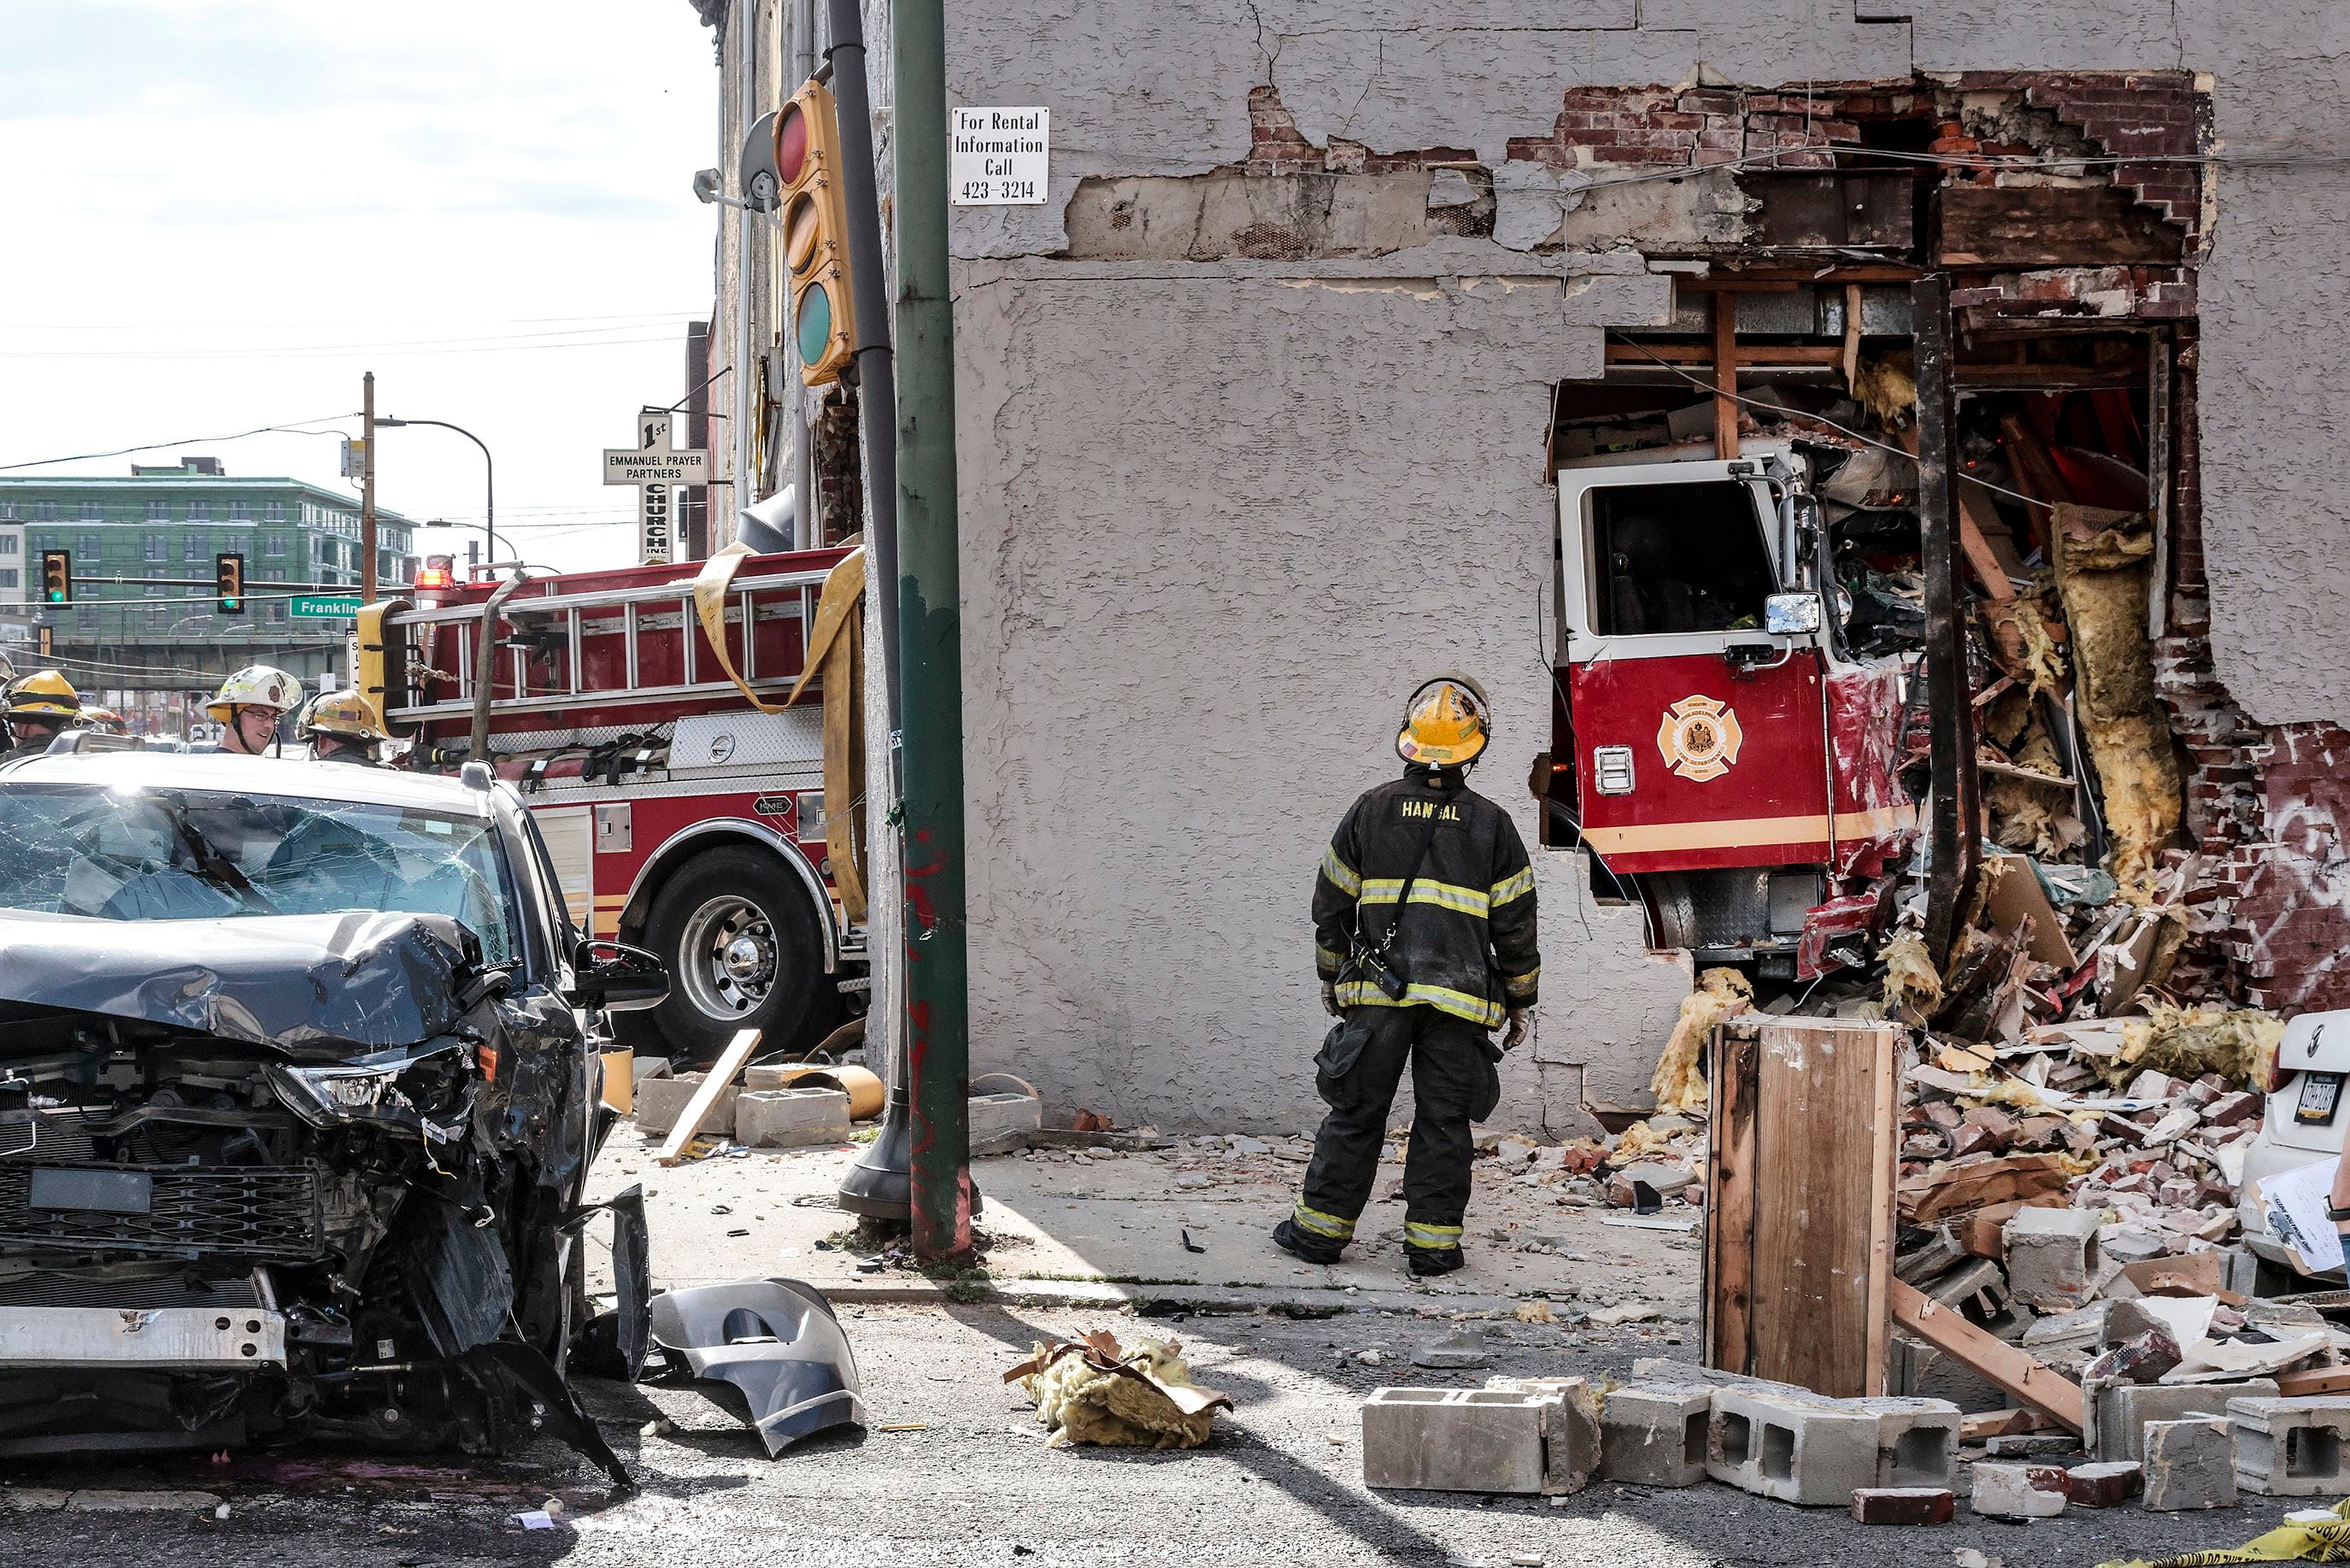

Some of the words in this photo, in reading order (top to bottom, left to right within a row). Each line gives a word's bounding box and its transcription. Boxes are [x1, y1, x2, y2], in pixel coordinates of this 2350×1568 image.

[961, 113, 984, 130] For
[992, 113, 1038, 130] Rental
[956, 136, 1043, 153] Information
[985, 158, 1013, 176] Call
[962, 181, 1034, 199] 423-3214
[644, 423, 667, 449] 1st
[610, 456, 662, 466] EMMANUEL
[667, 456, 702, 466] PRAYER
[626, 469, 682, 479] PARTNERS
[646, 484, 667, 547] CHURCH
[302, 602, 357, 613] Franklin
[1681, 710, 1717, 721] PHILADELPHIA
[1678, 752, 1689, 762] FIRE
[1690, 750, 1722, 766] DEPARTMENT
